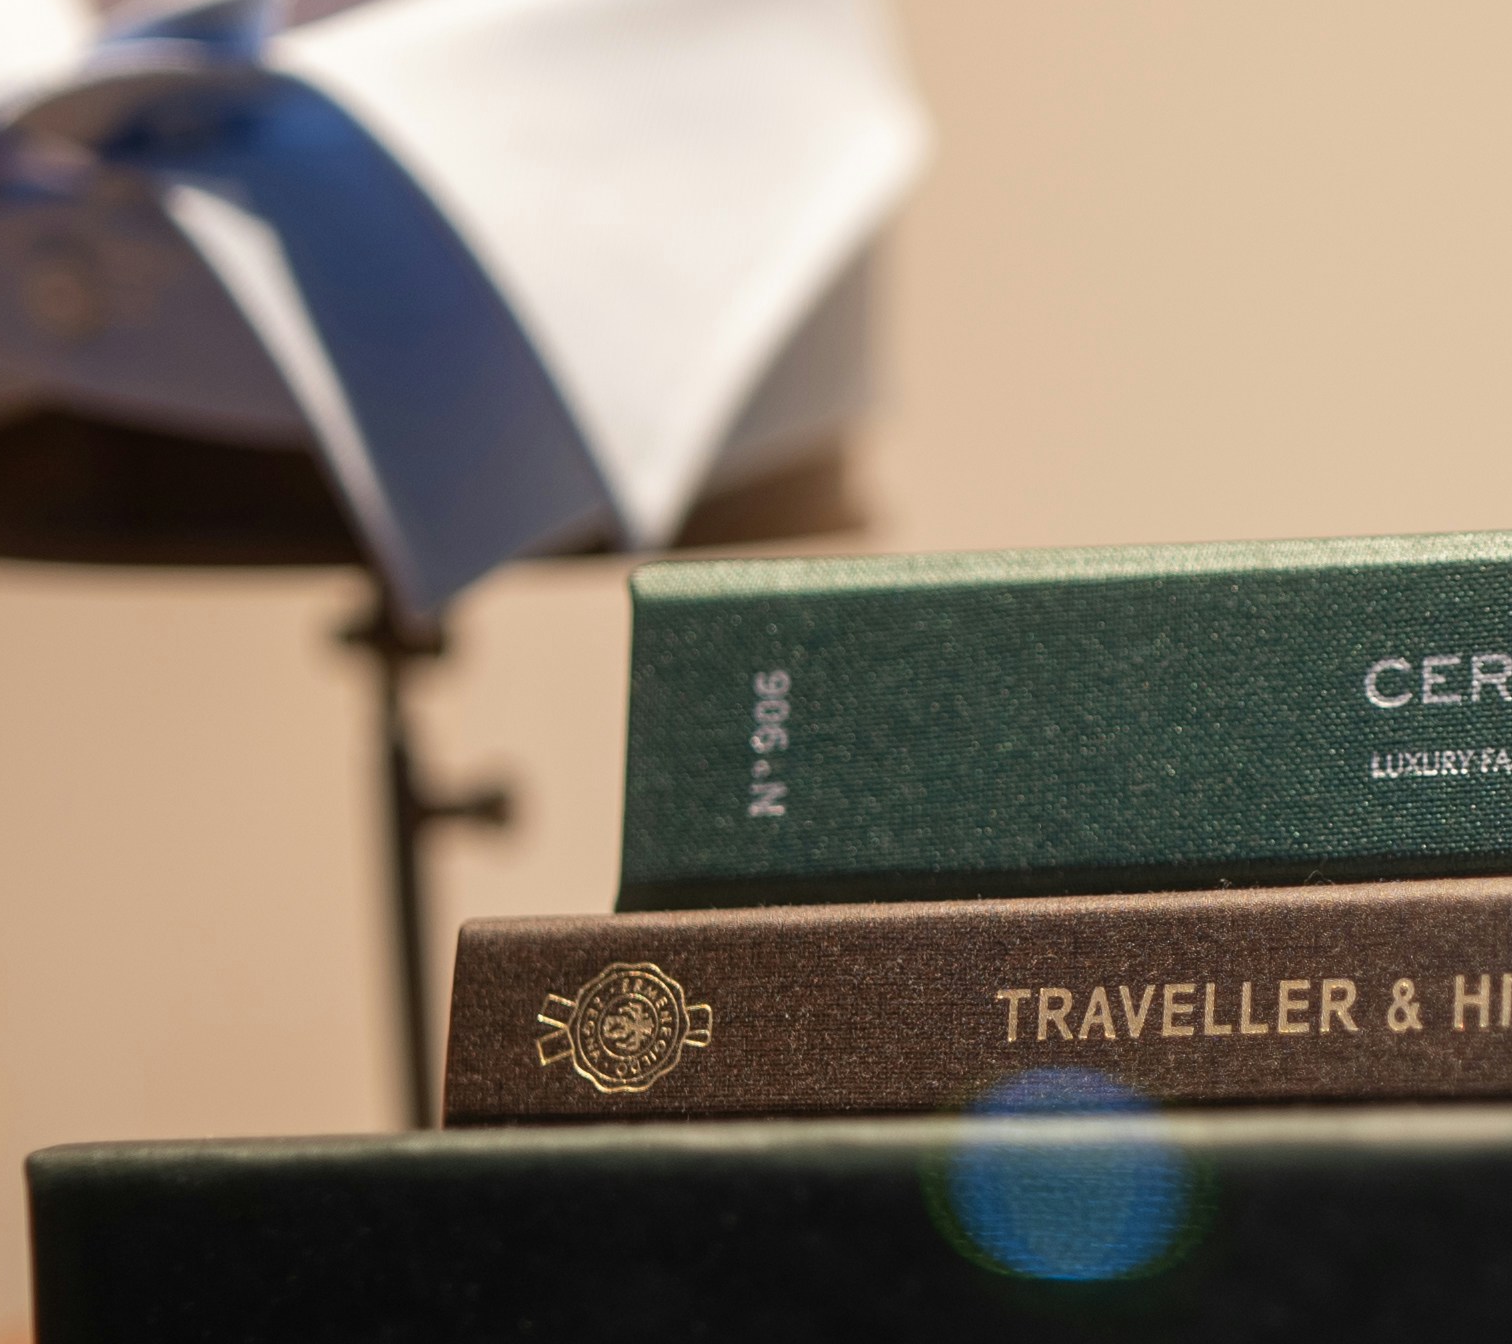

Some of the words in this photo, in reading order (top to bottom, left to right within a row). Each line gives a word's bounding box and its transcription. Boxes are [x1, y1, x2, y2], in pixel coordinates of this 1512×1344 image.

[1370, 751, 1472, 780] LUXURY
[998, 978, 1356, 1042] TRAVELLER
[1386, 977, 1422, 1031] &
